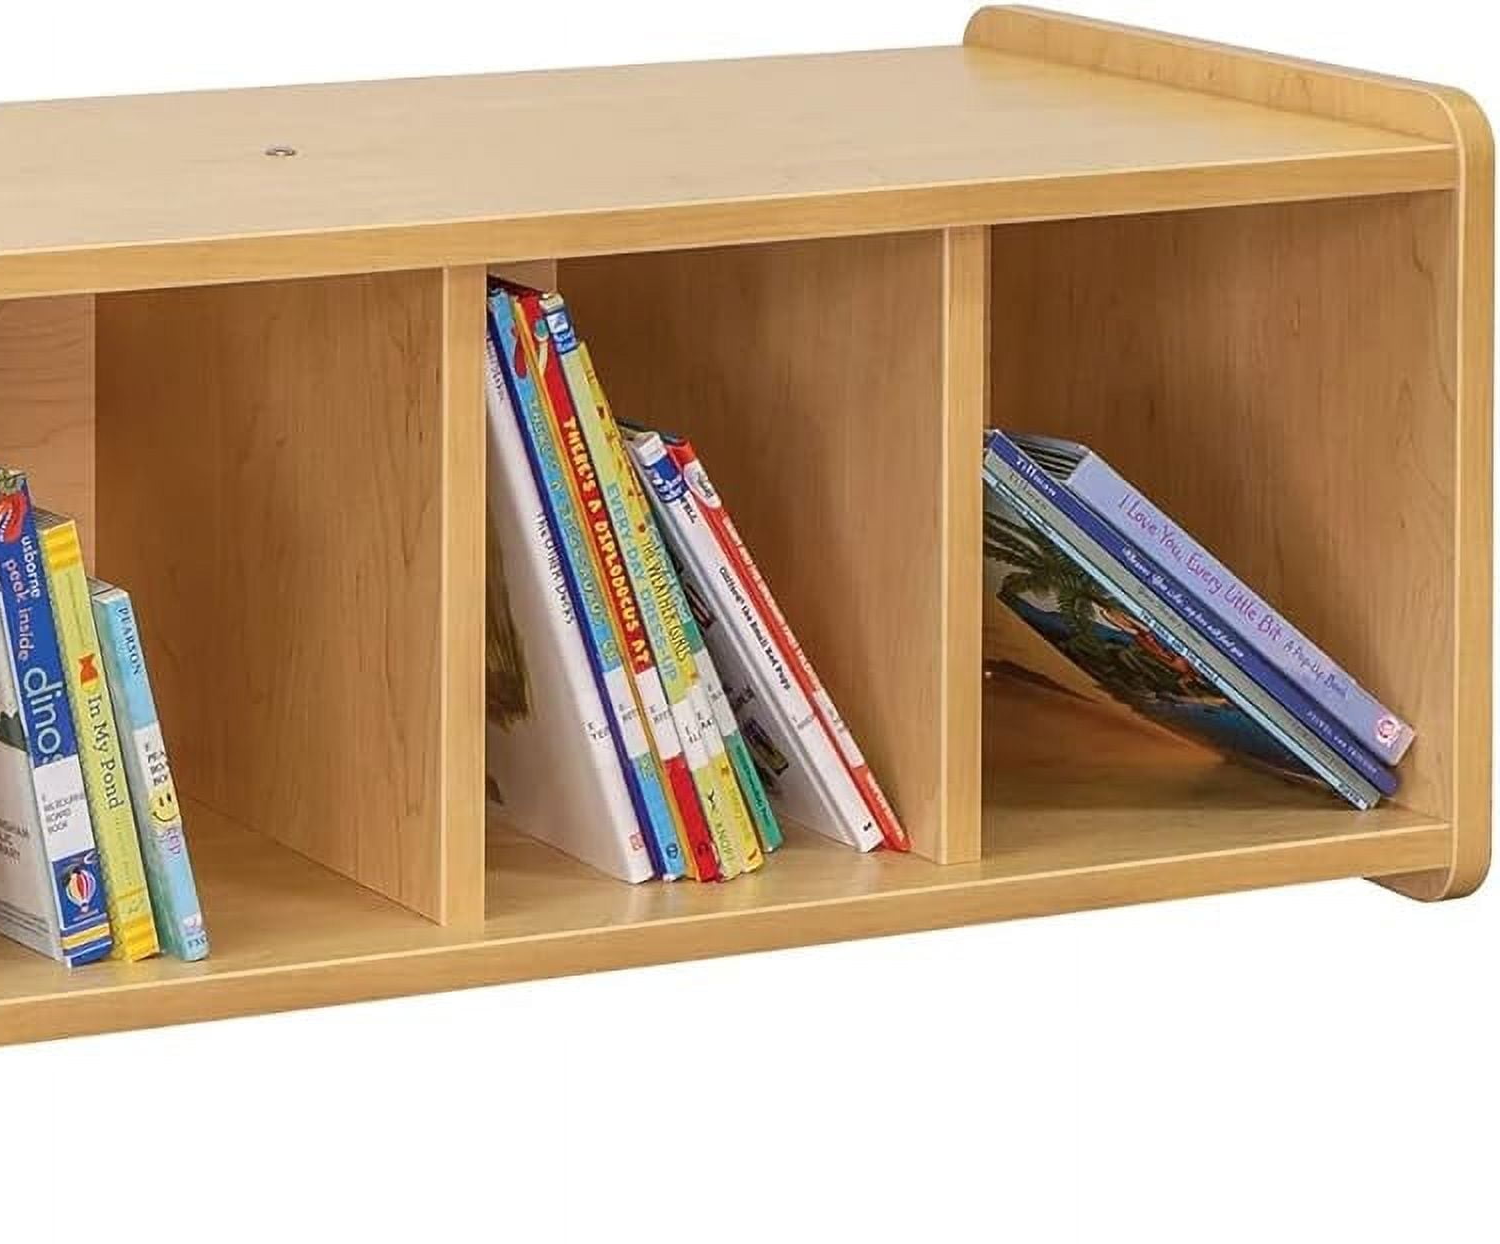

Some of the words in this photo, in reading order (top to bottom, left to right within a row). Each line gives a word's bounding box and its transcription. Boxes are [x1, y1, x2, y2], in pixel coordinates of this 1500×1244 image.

[563, 416, 596, 493] THERE'S
[1015, 457, 1058, 495] Tillman
[588, 500, 602, 514] A
[21, 535, 41, 599] usborne
[594, 517, 640, 636] DIPLODOCUS
[606, 483, 646, 581] EVERY-DAY
[638, 588, 678, 681] DRESS-UP
[647, 562, 678, 622] WEATHER
[1118, 494, 1129, 506] I
[1127, 502, 1161, 534] Love
[1155, 526, 1189, 558] You,
[1183, 552, 1226, 593] Every
[1223, 584, 1261, 620] Little
[1256, 613, 1285, 641] Bit
[3, 558, 31, 603] peek
[17, 607, 35, 662] inside
[741, 605, 754, 620] the
[118, 607, 142, 677] PEARSON
[630, 639, 650, 668] AT
[86, 694, 104, 719] In
[88, 726, 110, 762] My
[97, 762, 125, 811] Pond
